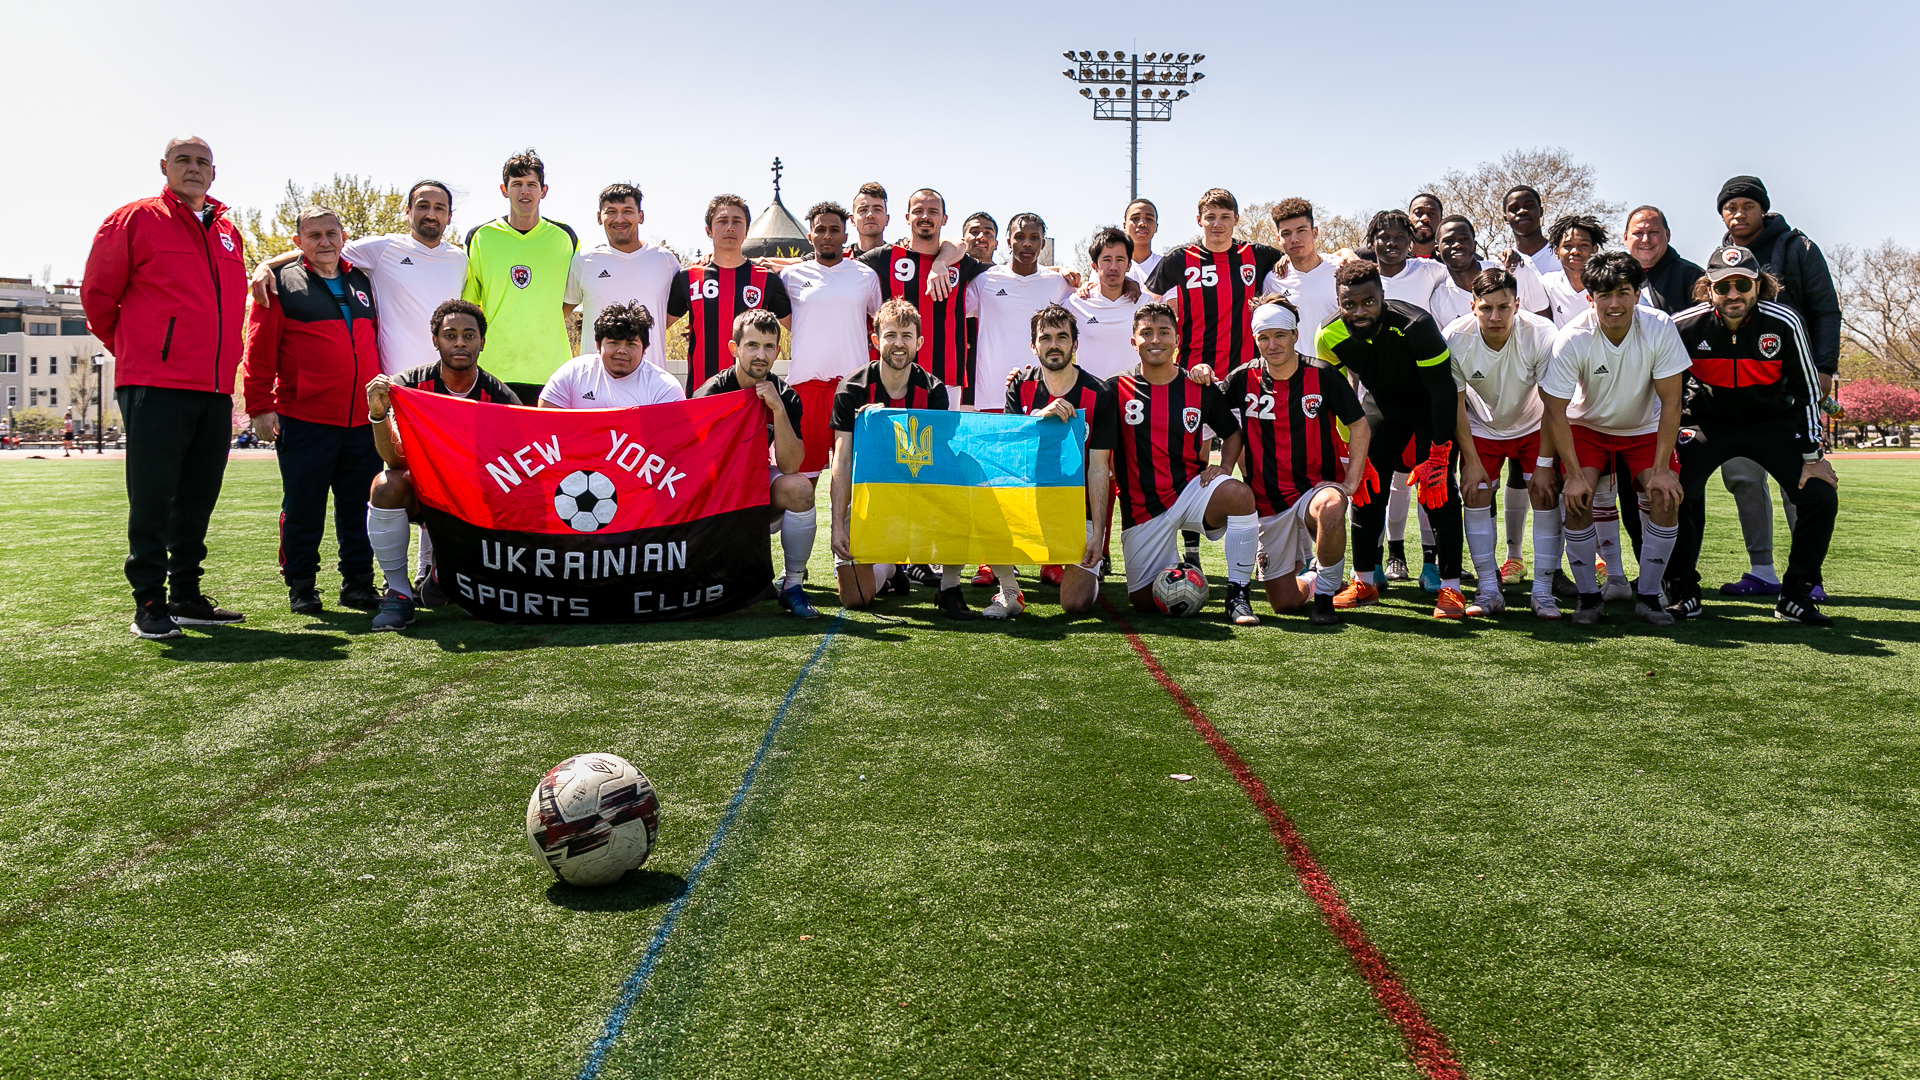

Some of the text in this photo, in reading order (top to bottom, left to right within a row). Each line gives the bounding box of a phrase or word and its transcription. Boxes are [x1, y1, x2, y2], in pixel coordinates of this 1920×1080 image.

[894, 257, 916, 282] 9
[1184, 264, 1219, 289] 25
[689, 278, 720, 301] 16
[1124, 399, 1145, 426] 8
[1244, 392, 1277, 420] 22
[485, 429, 687, 498] NEW YORK
[481, 539, 687, 580] UKRAINIAN
[456, 572, 724, 617] SPORTS CLUB
